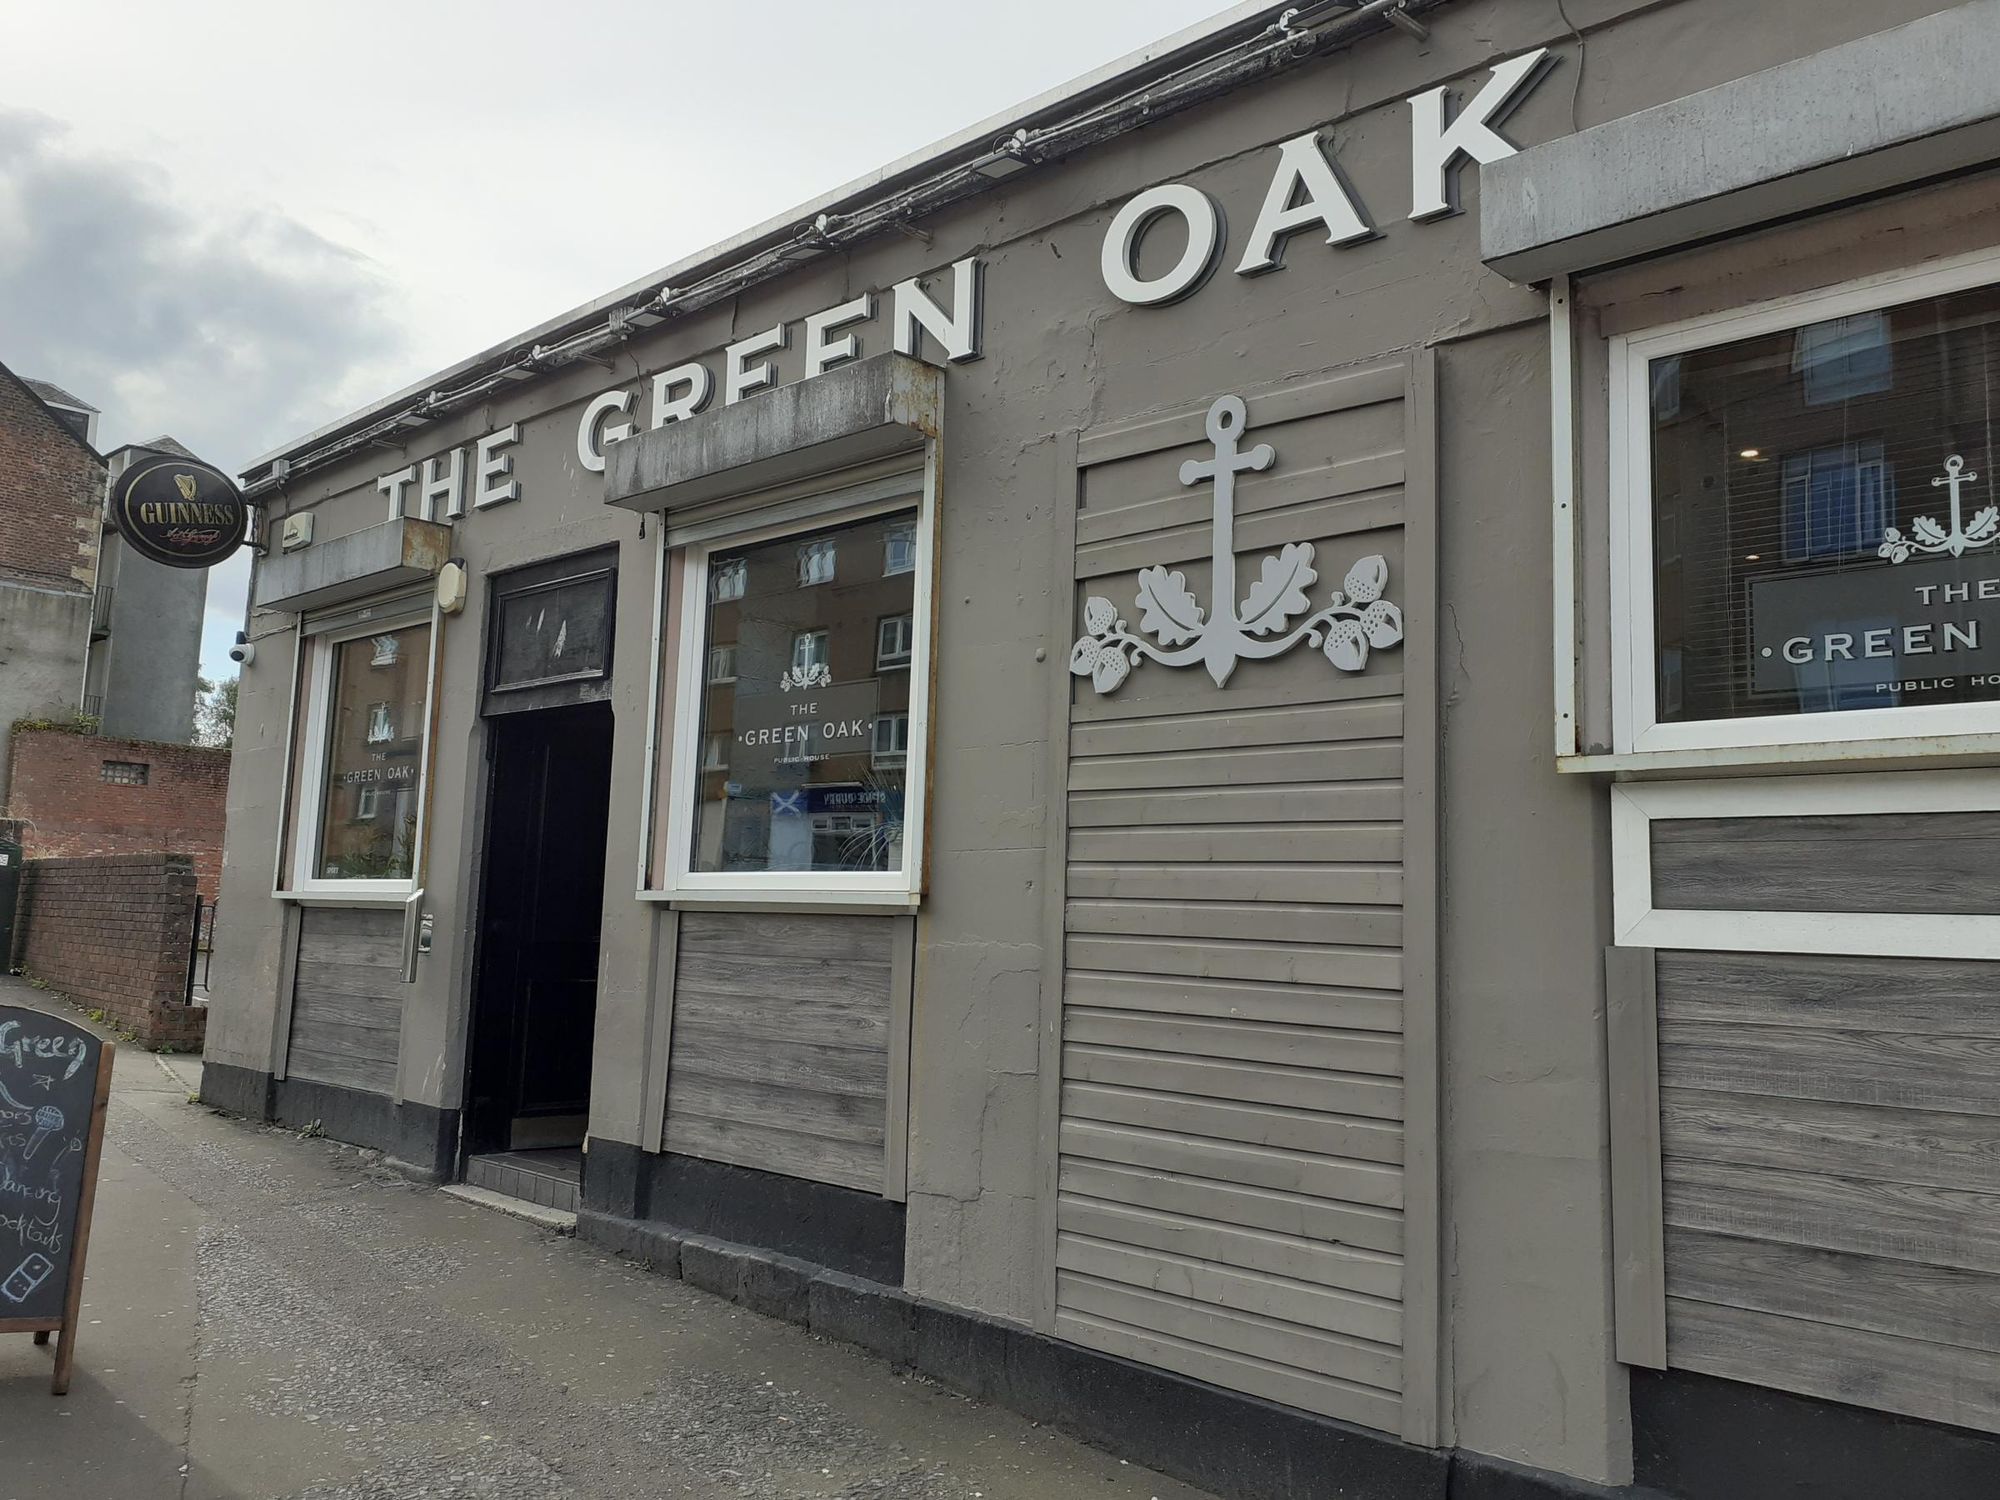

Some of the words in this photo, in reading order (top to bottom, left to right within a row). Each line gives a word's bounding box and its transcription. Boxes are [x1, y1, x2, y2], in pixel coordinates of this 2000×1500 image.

[377, 422, 518, 519] THE
[577, 256, 981, 471] GREEN
[1101, 47, 1549, 303] OAK
[140, 502, 234, 525] GUINNESS
[1915, 578, 2000, 605] THE
[1783, 620, 1979, 664] GREEN
[1876, 678, 1955, 693] PUBLIC
[790, 702, 818, 715] THE
[745, 725, 809, 746] GREEN
[823, 719, 863, 739] OAK
[371, 752, 387, 761] THE
[773, 756, 800, 764] PUBLIC
[803, 753, 831, 762] HOUSE
[346, 768, 381, 783] GREEN
[387, 765, 409, 780] OAK
